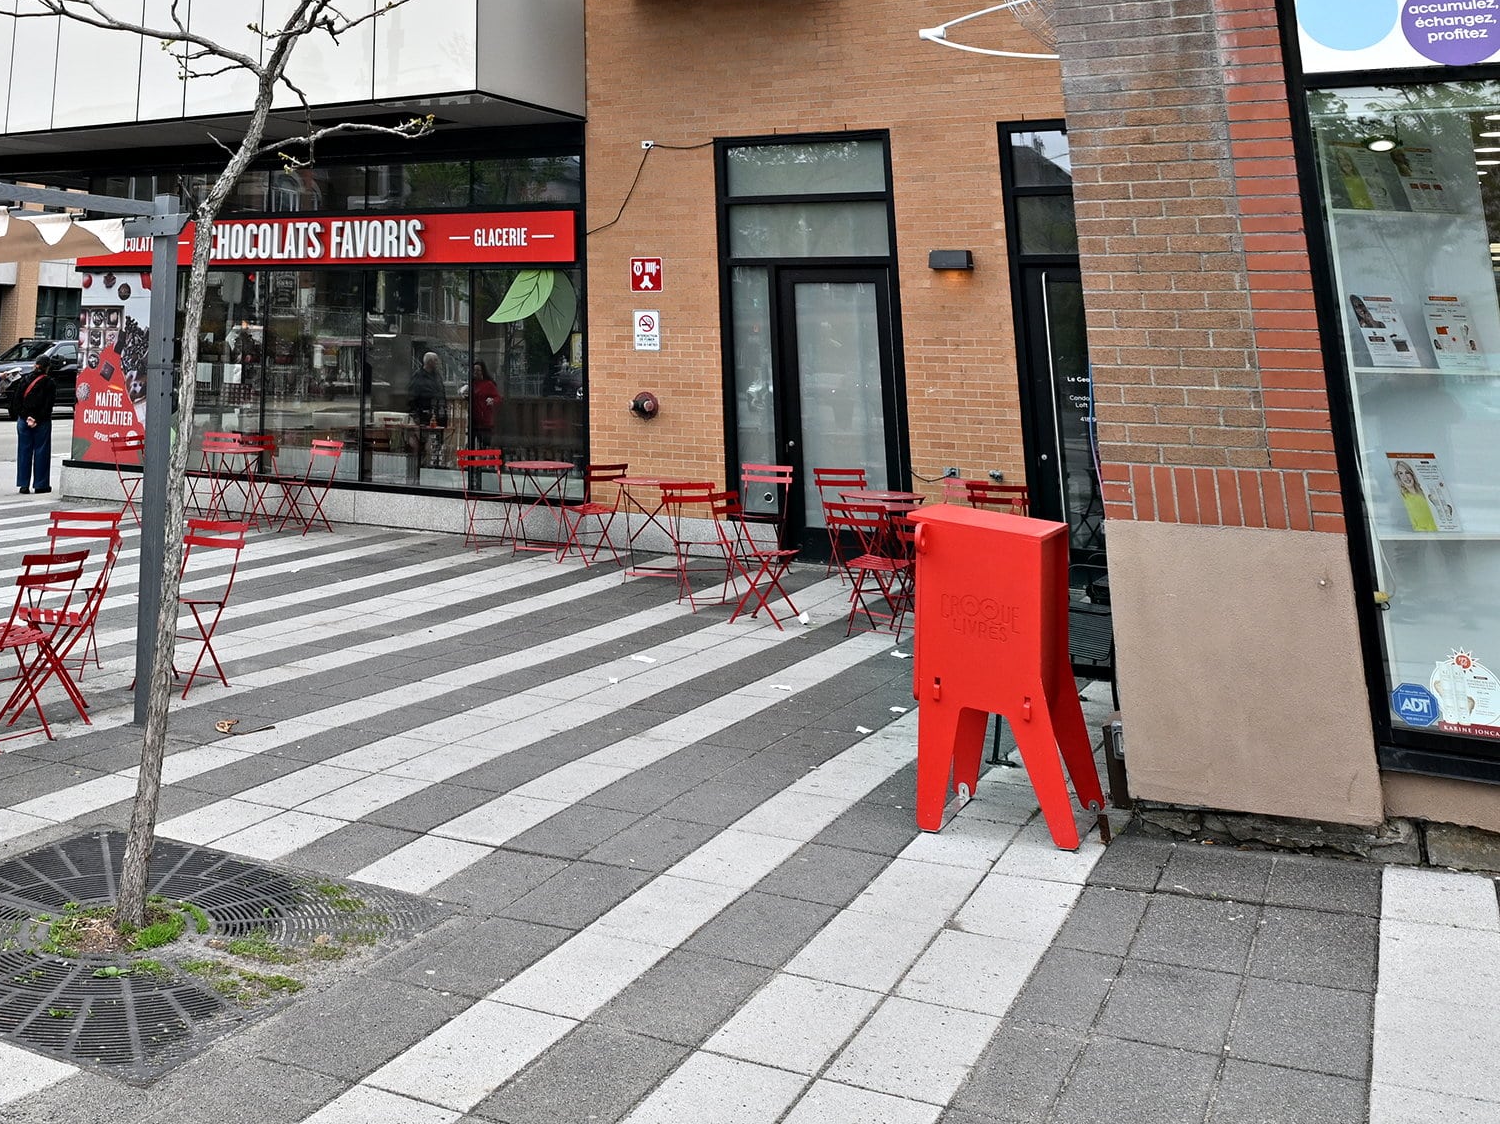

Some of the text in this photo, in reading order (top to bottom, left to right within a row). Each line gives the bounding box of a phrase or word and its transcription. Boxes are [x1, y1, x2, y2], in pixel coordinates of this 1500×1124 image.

[1408, 0, 1499, 14] accumulez,
[1415, 14, 1497, 28] échangez,
[1427, 28, 1488, 43] profitez
[124, 237, 153, 252] COLATI
[330, 219, 425, 258] FAVORIS
[474, 227, 528, 247] GLACERIE
[95, 390, 123, 407] MAÎTRE
[83, 409, 133, 426] CHOCOLATIER
[941, 593, 1020, 634] CROQUE
[953, 618, 1007, 643] LIVRES
[1401, 697, 1430, 713] ADT
[1443, 725, 1472, 733] KARINE
